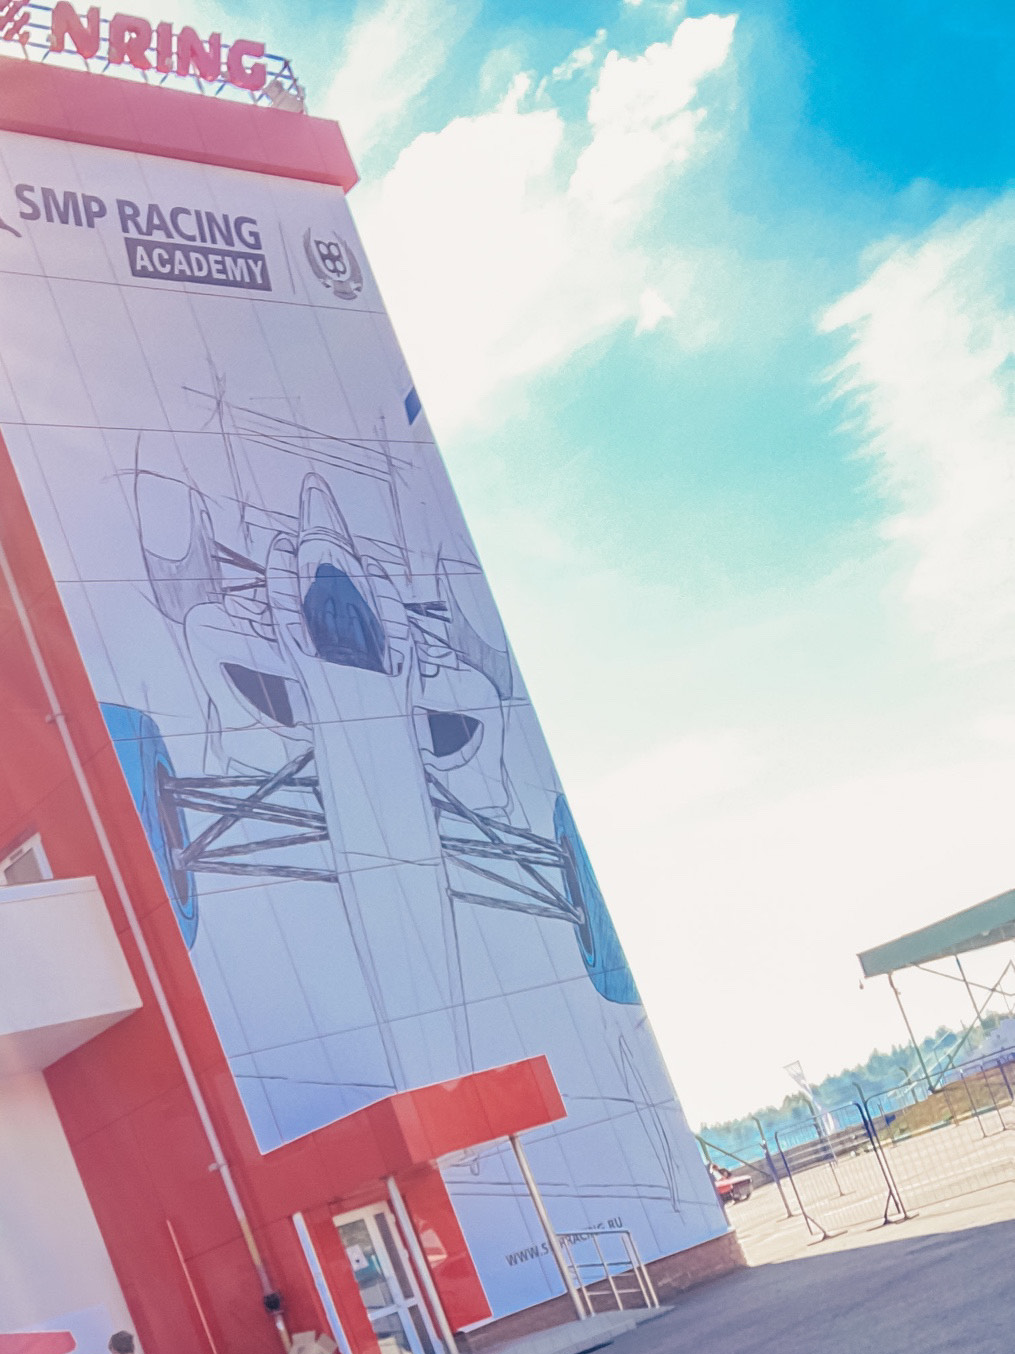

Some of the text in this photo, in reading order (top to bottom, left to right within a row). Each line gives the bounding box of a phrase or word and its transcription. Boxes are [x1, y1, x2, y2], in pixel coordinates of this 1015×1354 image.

[51, 0, 267, 92] NRING
[15, 183, 263, 250] SMP RACING
[136, 246, 264, 284] ACADEMY
